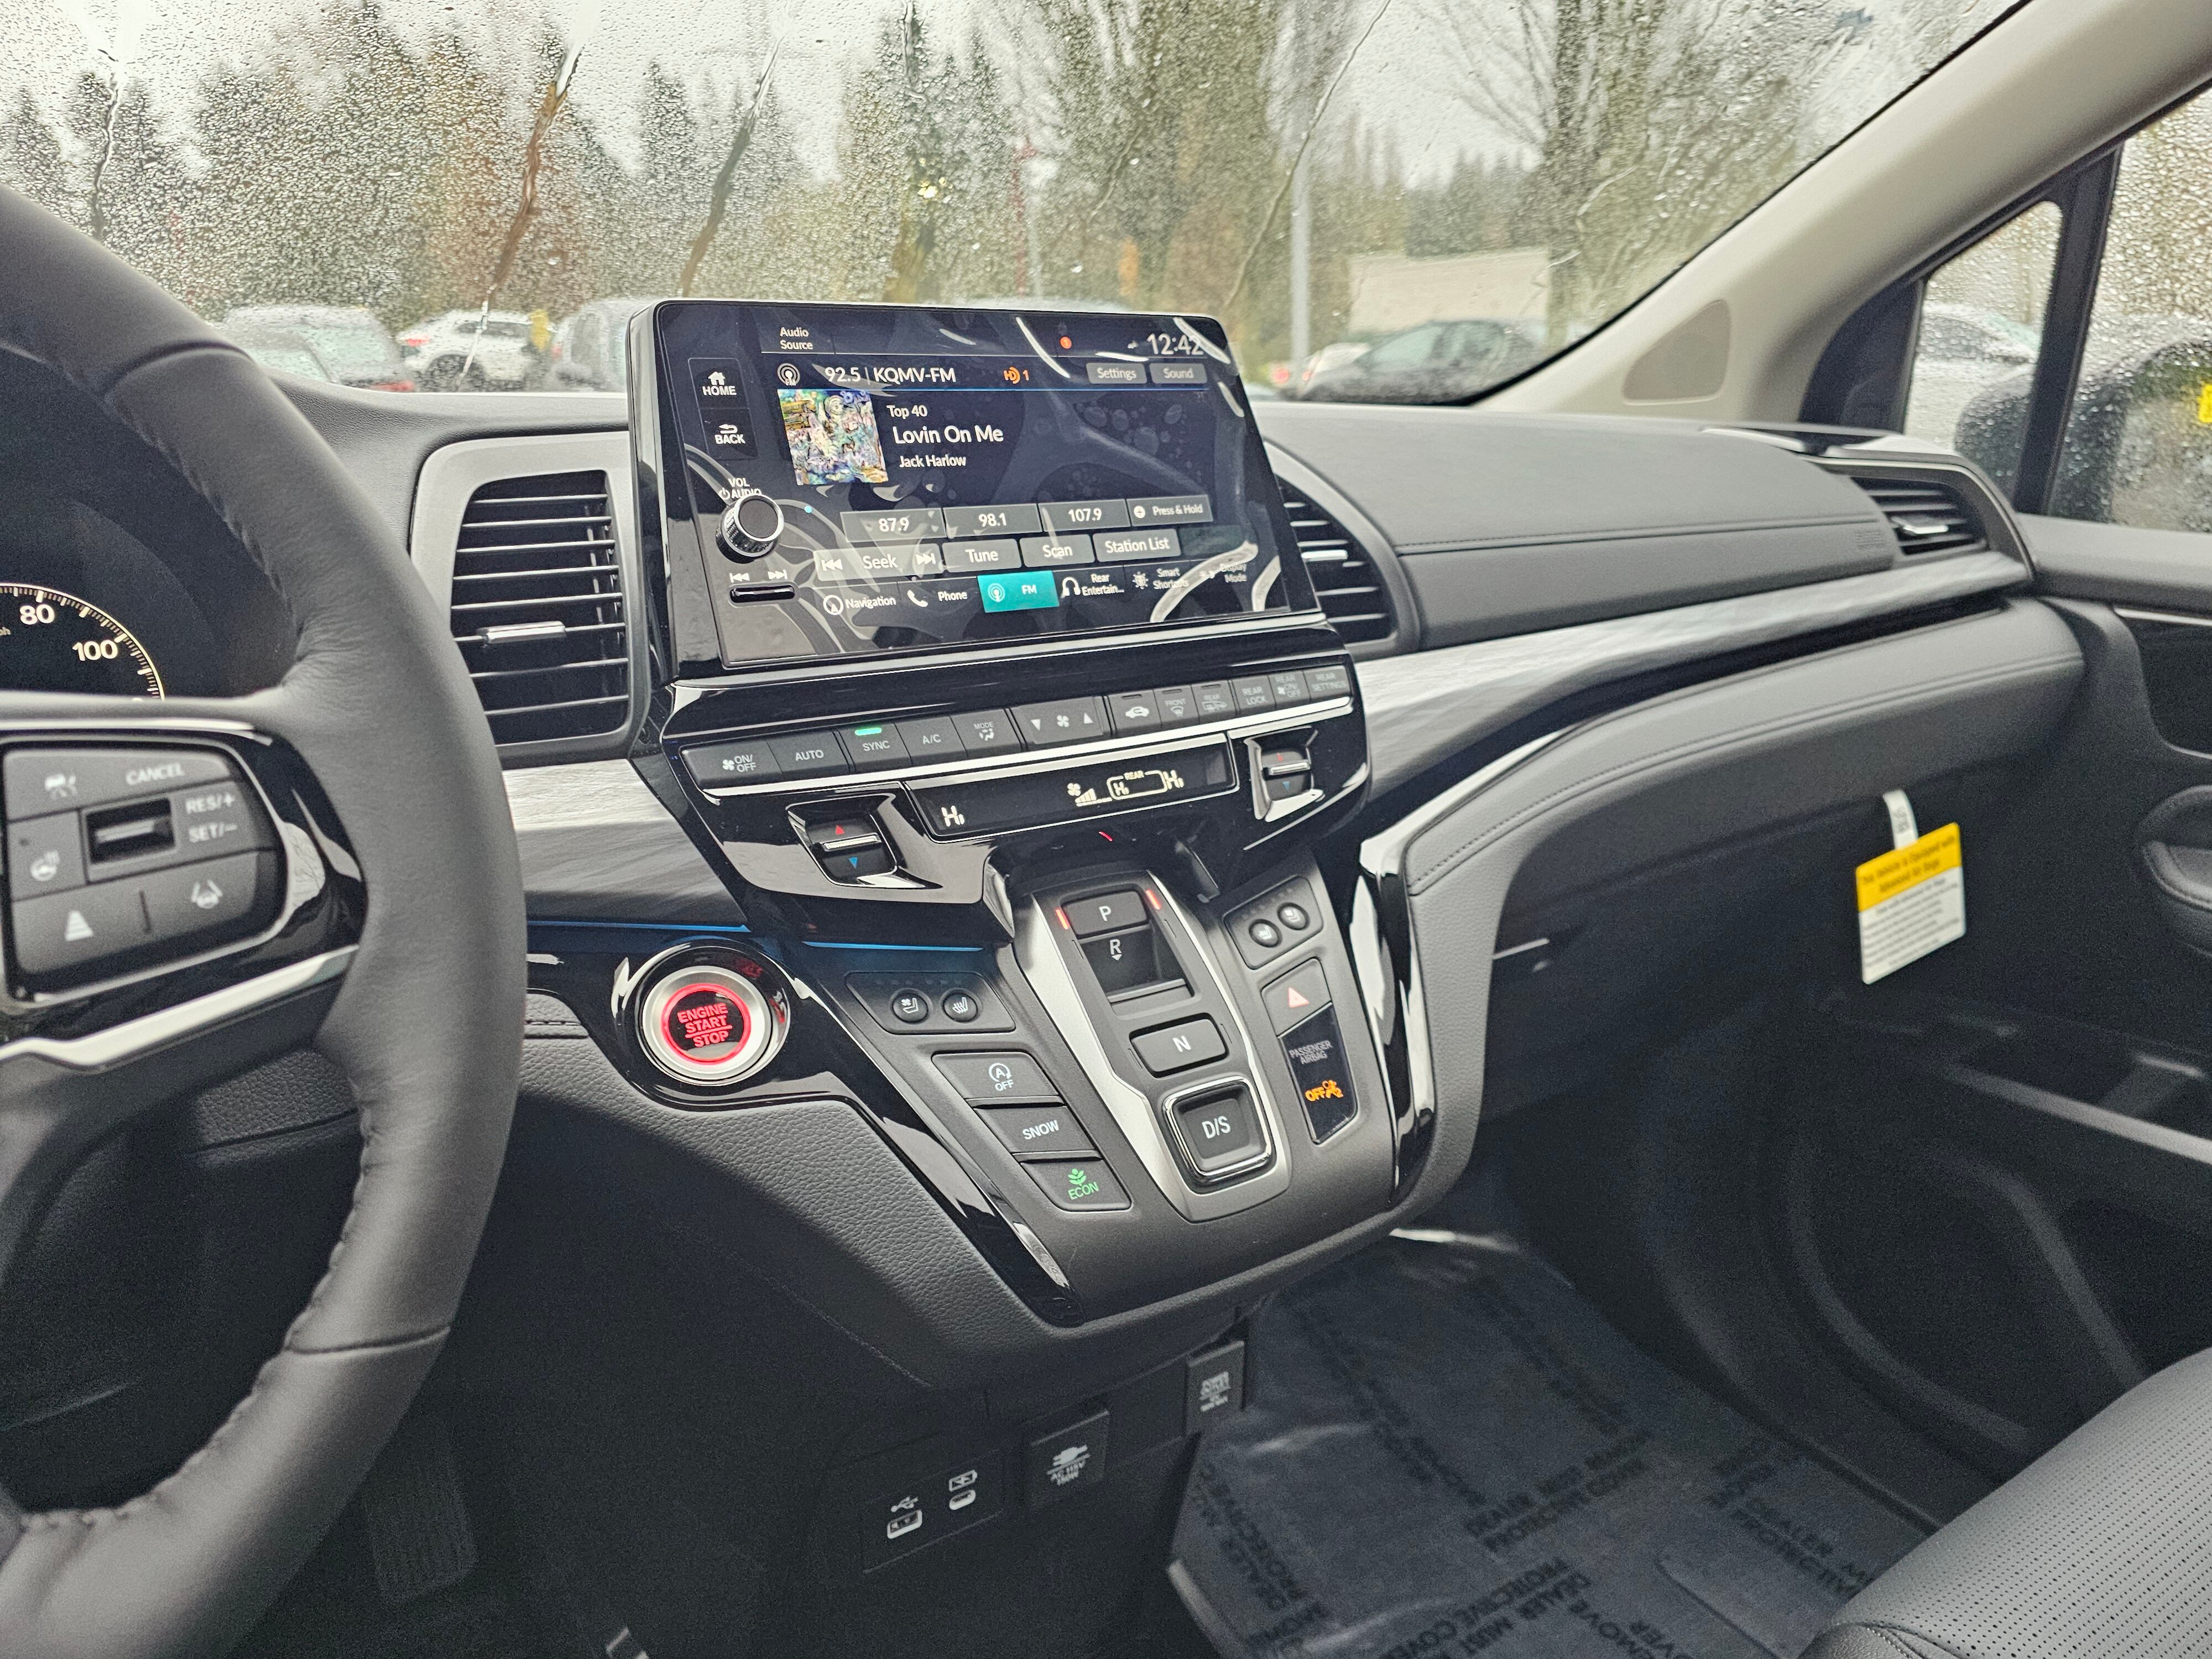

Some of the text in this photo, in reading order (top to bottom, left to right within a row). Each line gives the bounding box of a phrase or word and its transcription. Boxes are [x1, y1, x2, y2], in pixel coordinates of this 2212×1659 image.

[780, 326, 808, 337] Audio
[780, 340, 813, 350] Source
[1147, 333, 1204, 355] 12:42
[825, 367, 956, 383] 92.5 KQMV-FM
[1097, 367, 1136, 380] Settings
[1164, 368, 1194, 379] Sound
[702, 386, 737, 396] HOME
[886, 405, 928, 419] Top 40
[714, 434, 746, 445] BACK
[893, 425, 1004, 445] Lovin On Me
[899, 455, 967, 468] Jack Harlow
[728, 478, 750, 487] VOL
[731, 488, 762, 499] AUDIO
[1068, 508, 1102, 522] 107.9
[1152, 503, 1203, 517] Press & Hold
[879, 518, 909, 532] 87.9
[978, 513, 1007, 527] 98.1
[1042, 544, 1073, 558] Scan
[1105, 537, 1170, 554] Station List
[863, 555, 898, 570] Seek
[965, 549, 999, 562] Tune
[1091, 573, 1110, 583] Rear
[1157, 567, 1181, 577] Smart
[1224, 573, 1247, 583] Mode
[938, 590, 968, 602] Phone
[1021, 585, 1037, 596] FM
[845, 595, 896, 611] Navigation
[19, 604, 55, 625] 80
[72, 639, 118, 661] 100
[1242, 686, 1263, 695] REAR
[1165, 698, 1186, 707] FRONT
[1245, 696, 1267, 705] LOCK
[974, 721, 994, 730] MODE
[862, 740, 890, 752] SYNC
[922, 734, 941, 744] A/C
[795, 749, 825, 762] AUTO
[126, 763, 185, 785] CANCEL
[737, 762, 757, 773] OFF
[1124, 769, 1145, 780] REAR
[1099, 906, 1112, 921] P
[1109, 939, 1121, 955] R
[677, 1003, 728, 1024] ENGINE
[685, 1015, 727, 1034] START
[693, 1030, 729, 1047] STOP
[1172, 1036, 1192, 1052] N
[1288, 1040, 1333, 1058] PASSENGER
[1300, 1050, 1328, 1065] AIRBAG
[995, 1079, 1014, 1092] OFF
[1305, 1087, 1326, 1102] OFF
[1022, 1120, 1060, 1140] SNOW
[1202, 1116, 1231, 1139] D/S
[1068, 1181, 1099, 1199] ECON
